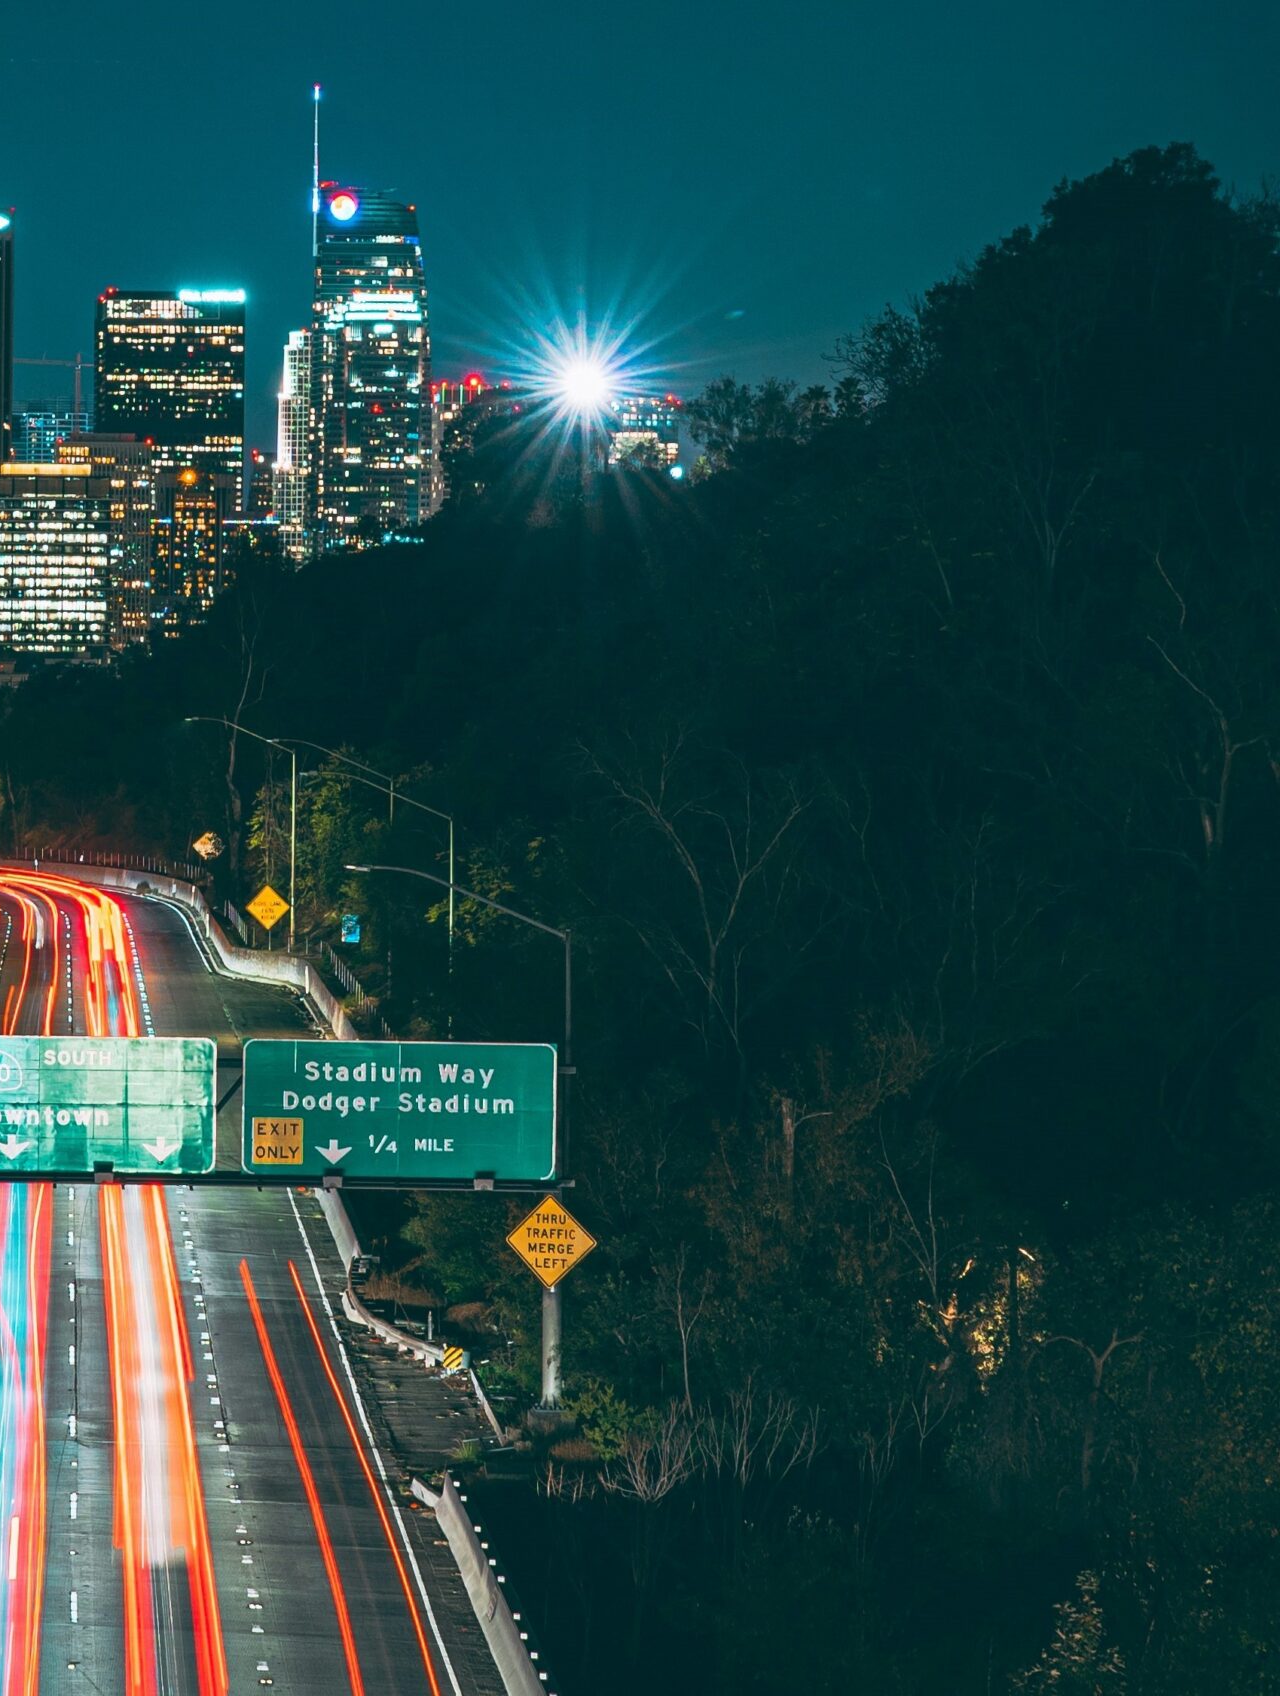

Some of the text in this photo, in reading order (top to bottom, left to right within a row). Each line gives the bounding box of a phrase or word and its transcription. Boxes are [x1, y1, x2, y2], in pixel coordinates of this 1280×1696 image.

[43, 1049, 113, 1067] SOUTH
[304, 1061, 495, 1089] Stadium Way
[282, 1090, 515, 1118] Dodger Stadium
[257, 1122, 299, 1136] EXIT
[414, 1138, 454, 1152] MILE
[255, 1145, 300, 1160] ONLY
[535, 1213, 567, 1225] THRU
[526, 1227, 576, 1240] TRAFFIC
[528, 1242, 575, 1255] MERGE
[535, 1257, 568, 1270] LEFT
